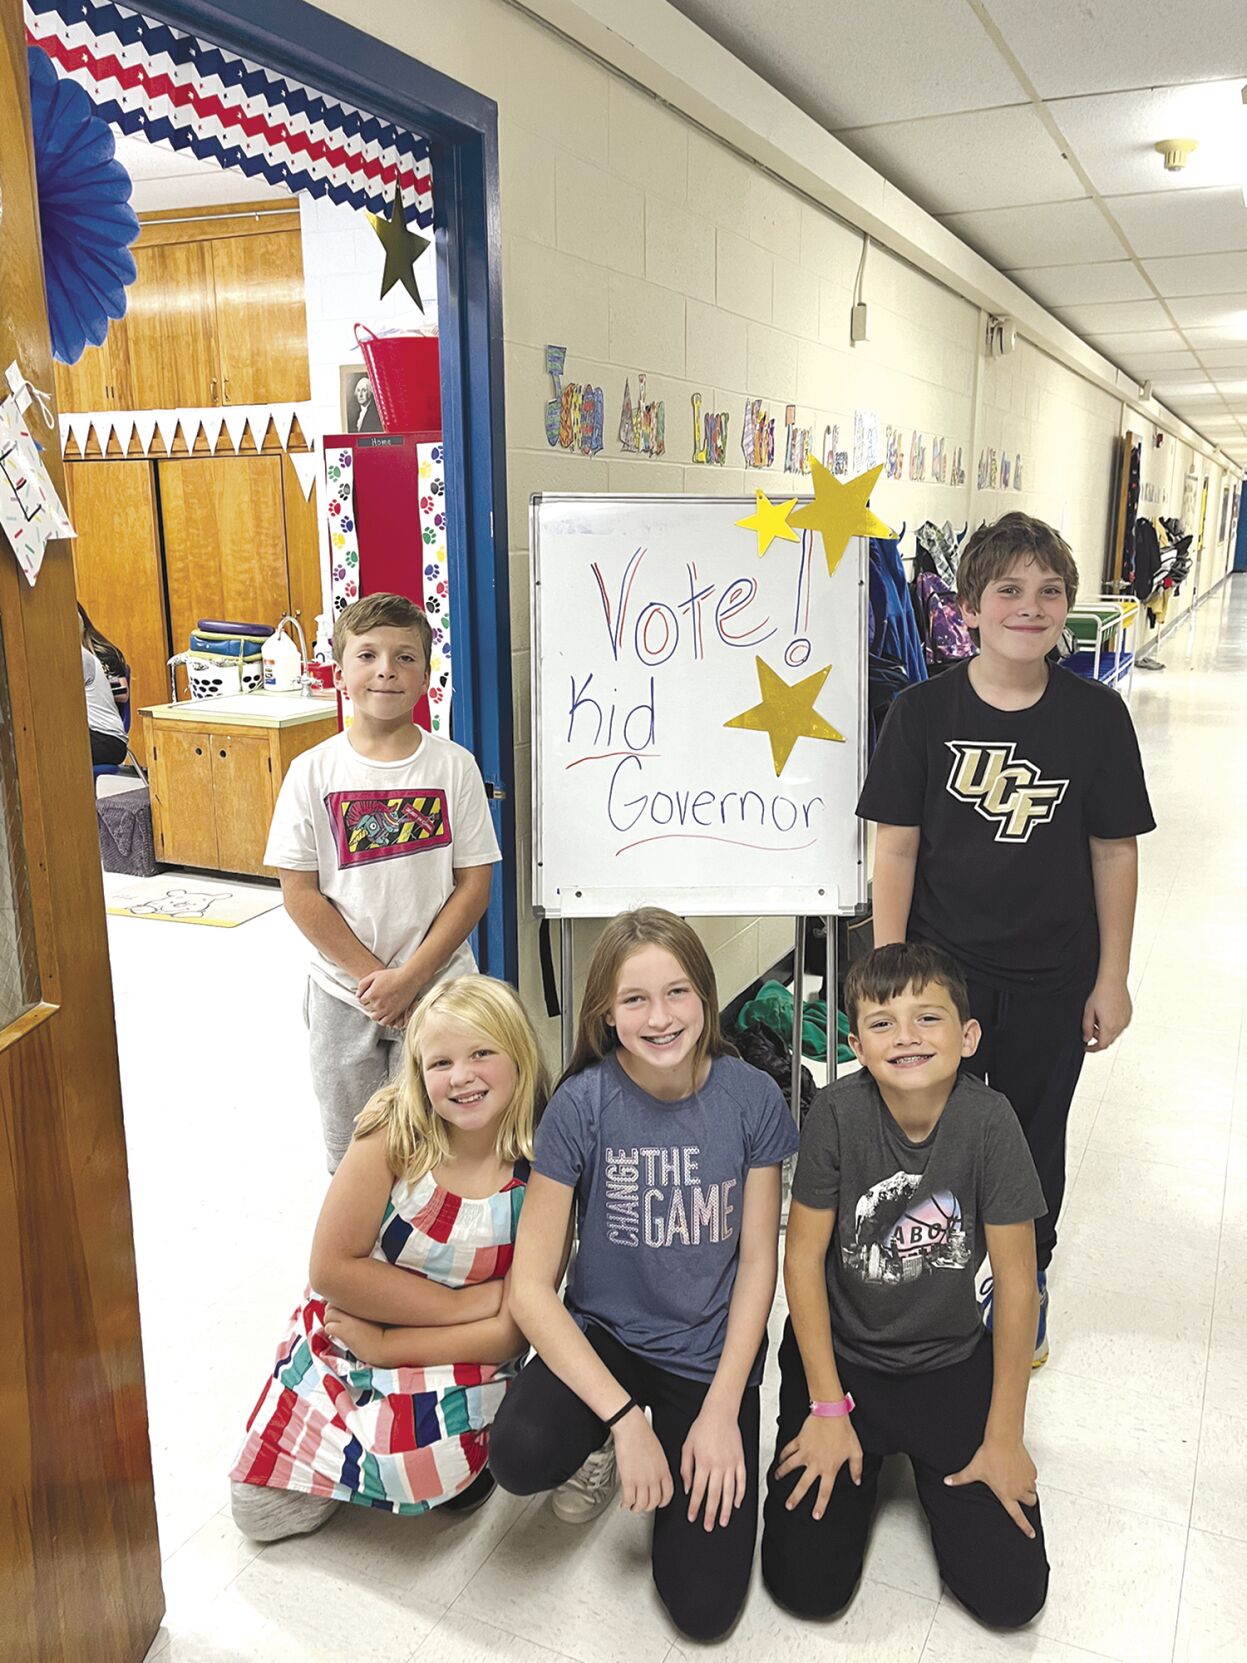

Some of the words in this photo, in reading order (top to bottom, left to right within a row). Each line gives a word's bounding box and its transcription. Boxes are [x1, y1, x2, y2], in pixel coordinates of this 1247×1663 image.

[371, 437, 392, 446] Home
[590, 528, 812, 667] Vote!
[567, 672, 656, 751] Kid
[607, 754, 825, 832] Governor
[944, 740, 1070, 843] UCF
[604, 1147, 639, 1248] CHANGE
[639, 1146, 701, 1187] THE
[642, 1178, 737, 1249] GAME
